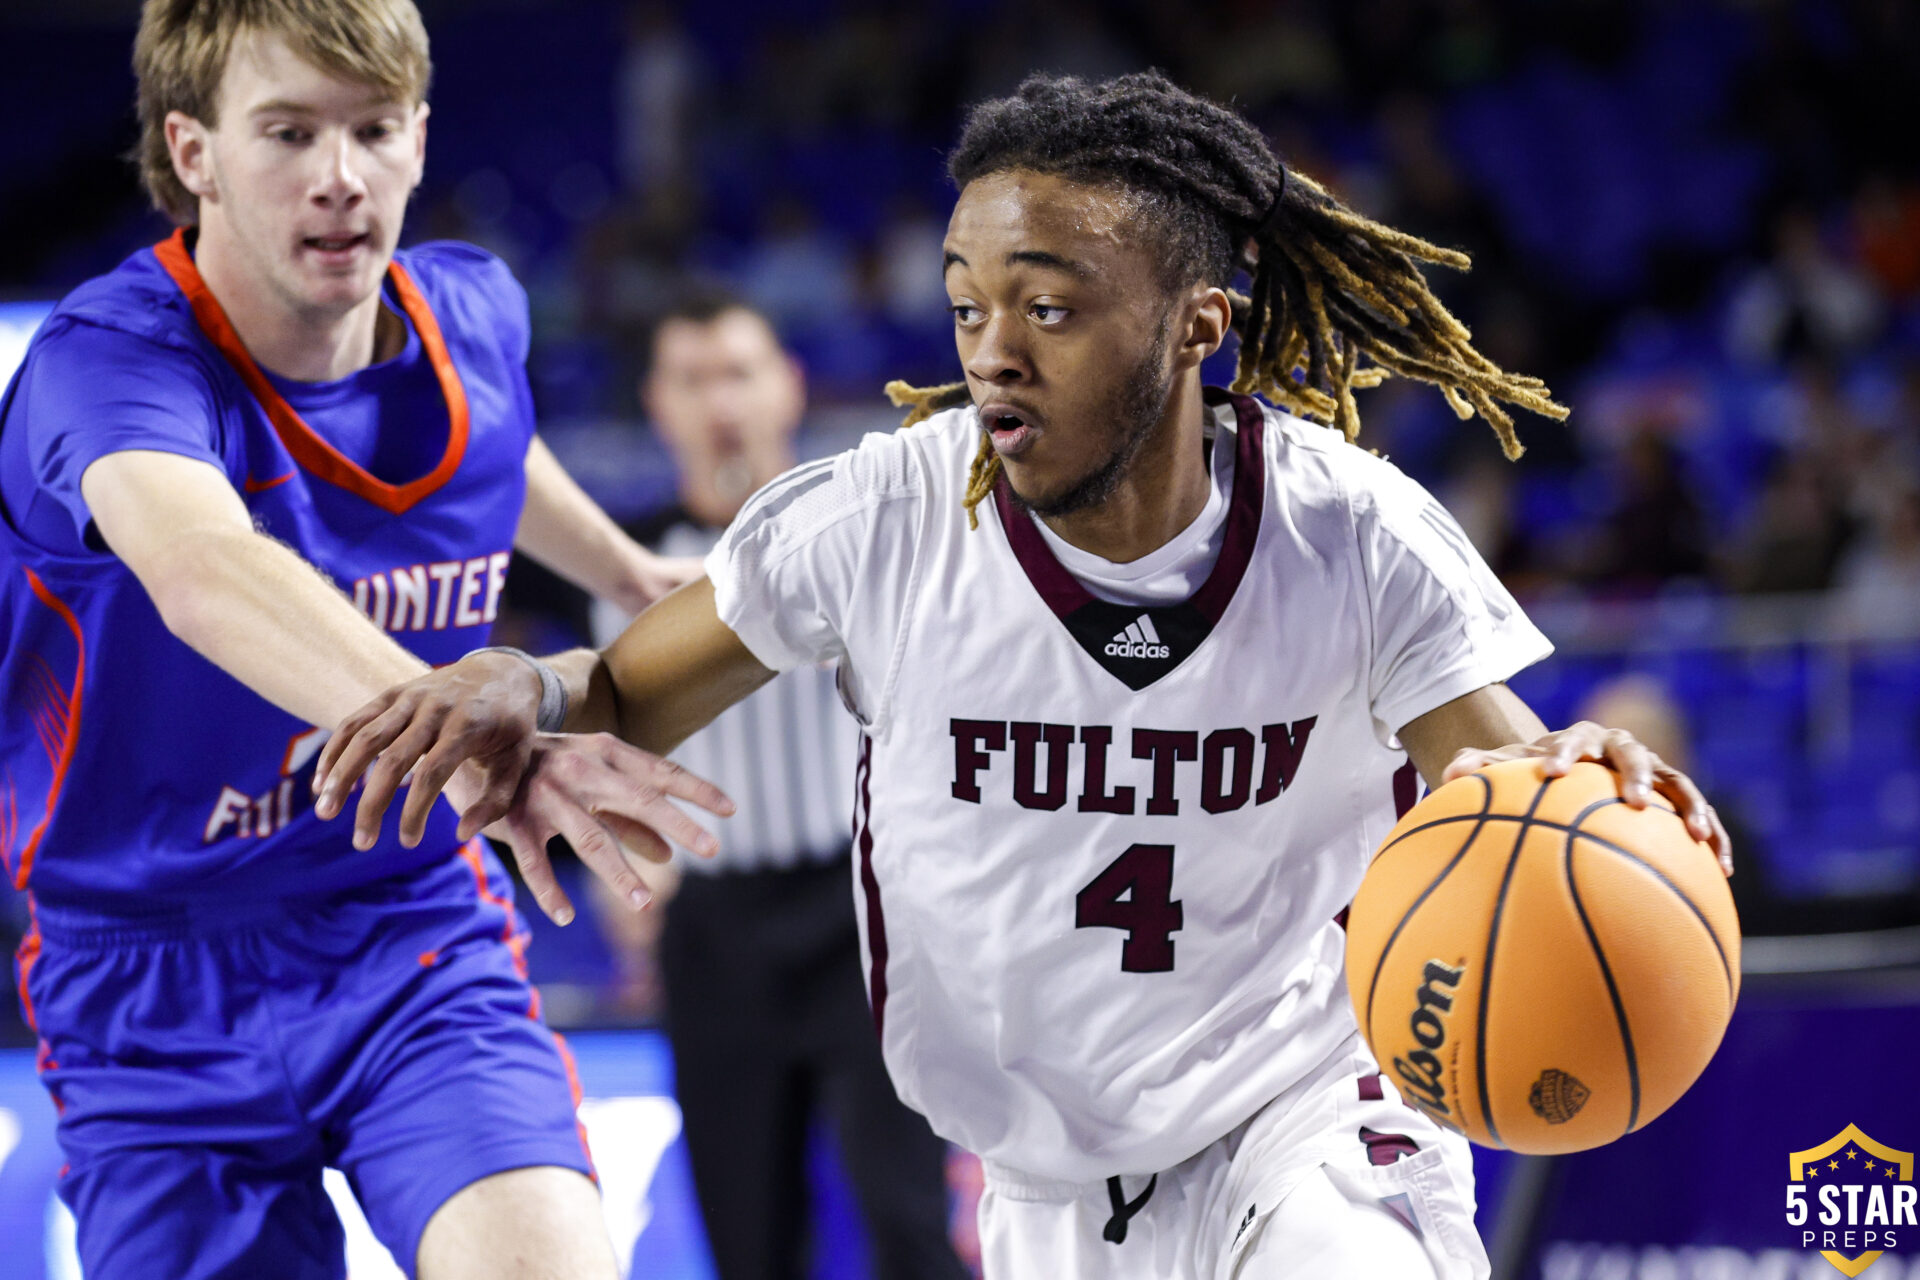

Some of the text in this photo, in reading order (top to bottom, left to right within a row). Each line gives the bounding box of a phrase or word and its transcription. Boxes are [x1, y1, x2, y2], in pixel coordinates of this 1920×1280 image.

[1104, 641, 1170, 659] adidas
[950, 715, 1319, 817] FULTON
[1075, 843, 1183, 974] 4
